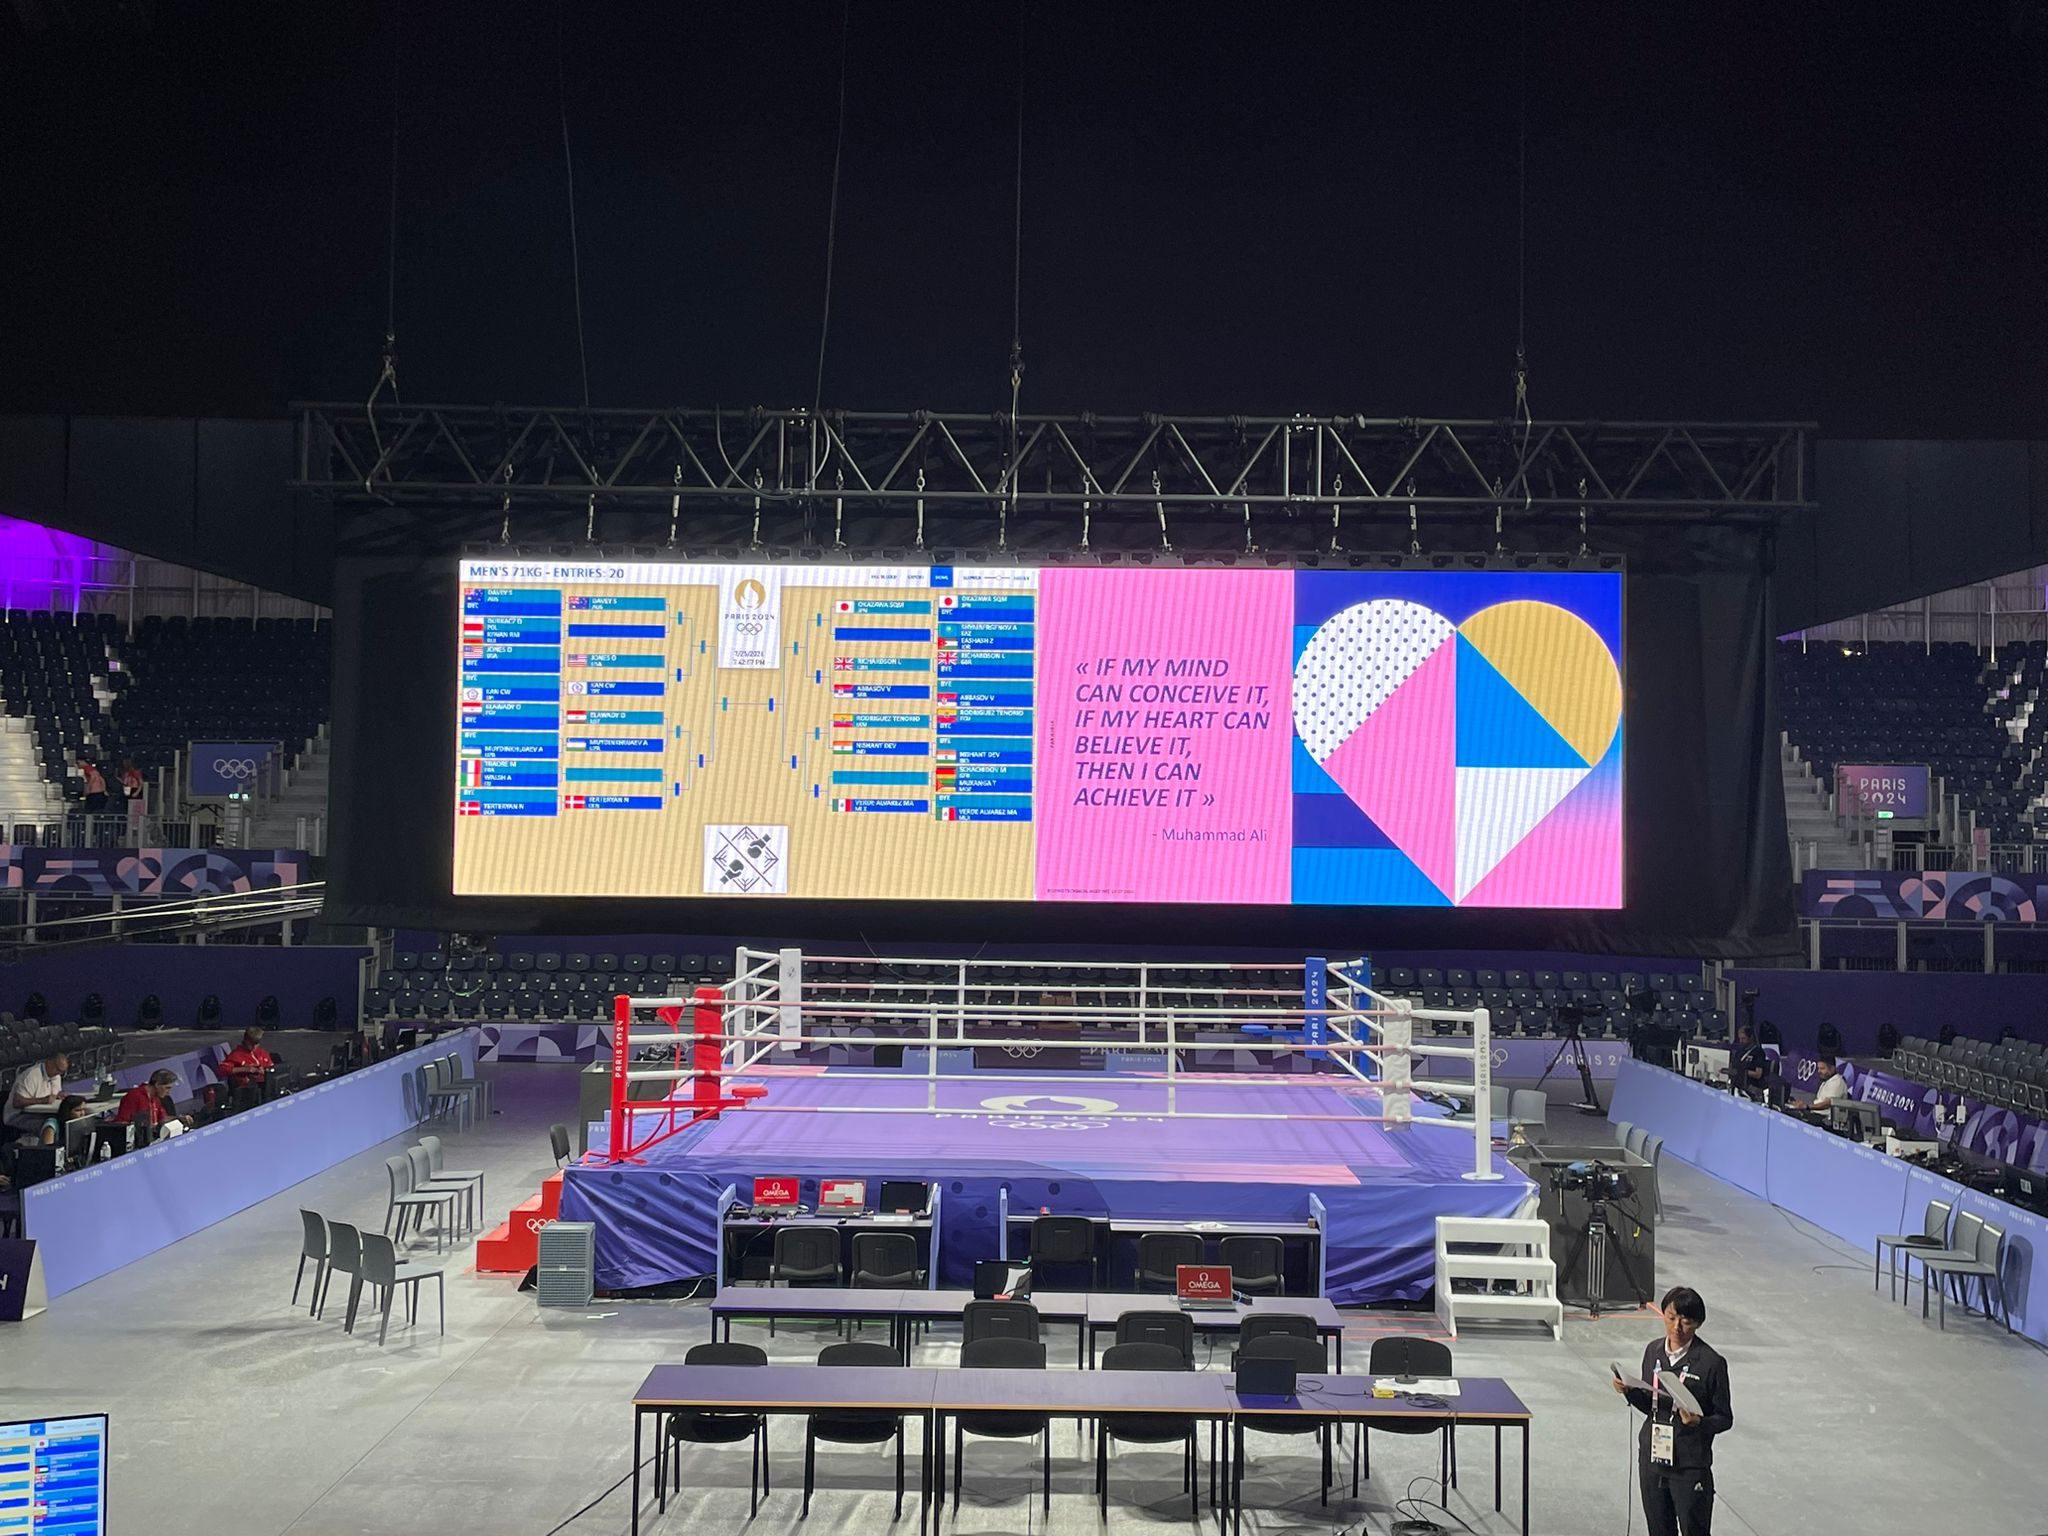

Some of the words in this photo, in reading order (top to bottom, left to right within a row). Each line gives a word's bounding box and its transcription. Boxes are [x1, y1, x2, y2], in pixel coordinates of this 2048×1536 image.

[470, 566, 508, 576] MEN'S
[513, 567, 541, 577] 71KG
[610, 568, 624, 578] 20
[1097, 658, 1116, 676] IF
[1121, 659, 1159, 676] MY
[1165, 659, 1229, 677] MIND
[1076, 684, 1122, 702] CAN
[1129, 685, 1240, 704] CONCEIVE
[1247, 686, 1269, 707] IT,
[1075, 710, 1095, 727] IF
[1100, 710, 1138, 728] MY
[1144, 710, 1218, 729] HEART
[1223, 711, 1270, 729] CAN
[1075, 736, 1163, 755] BELIEVE
[1169, 736, 1192, 758] IT,
[1076, 762, 1135, 780] THEN
[1141, 762, 1148, 780] I
[1155, 762, 1201, 781] CAN
[1861, 778, 1906, 790] PARIS
[1073, 788, 1169, 807] ACHIEVE
[1176, 789, 1197, 807] IT
[1162, 828, 1246, 841] Muhammad
[1249, 829, 1267, 842] Ali
[1311, 971, 1319, 1005] 2024
[616, 1020, 624, 1046] 2024
[615, 1050, 623, 1078] PARIS
[1871, 1087, 1894, 1105] PARIS
[1893, 1095, 1915, 1112] 2024
[1188, 1281, 1221, 1289] OMEGA
